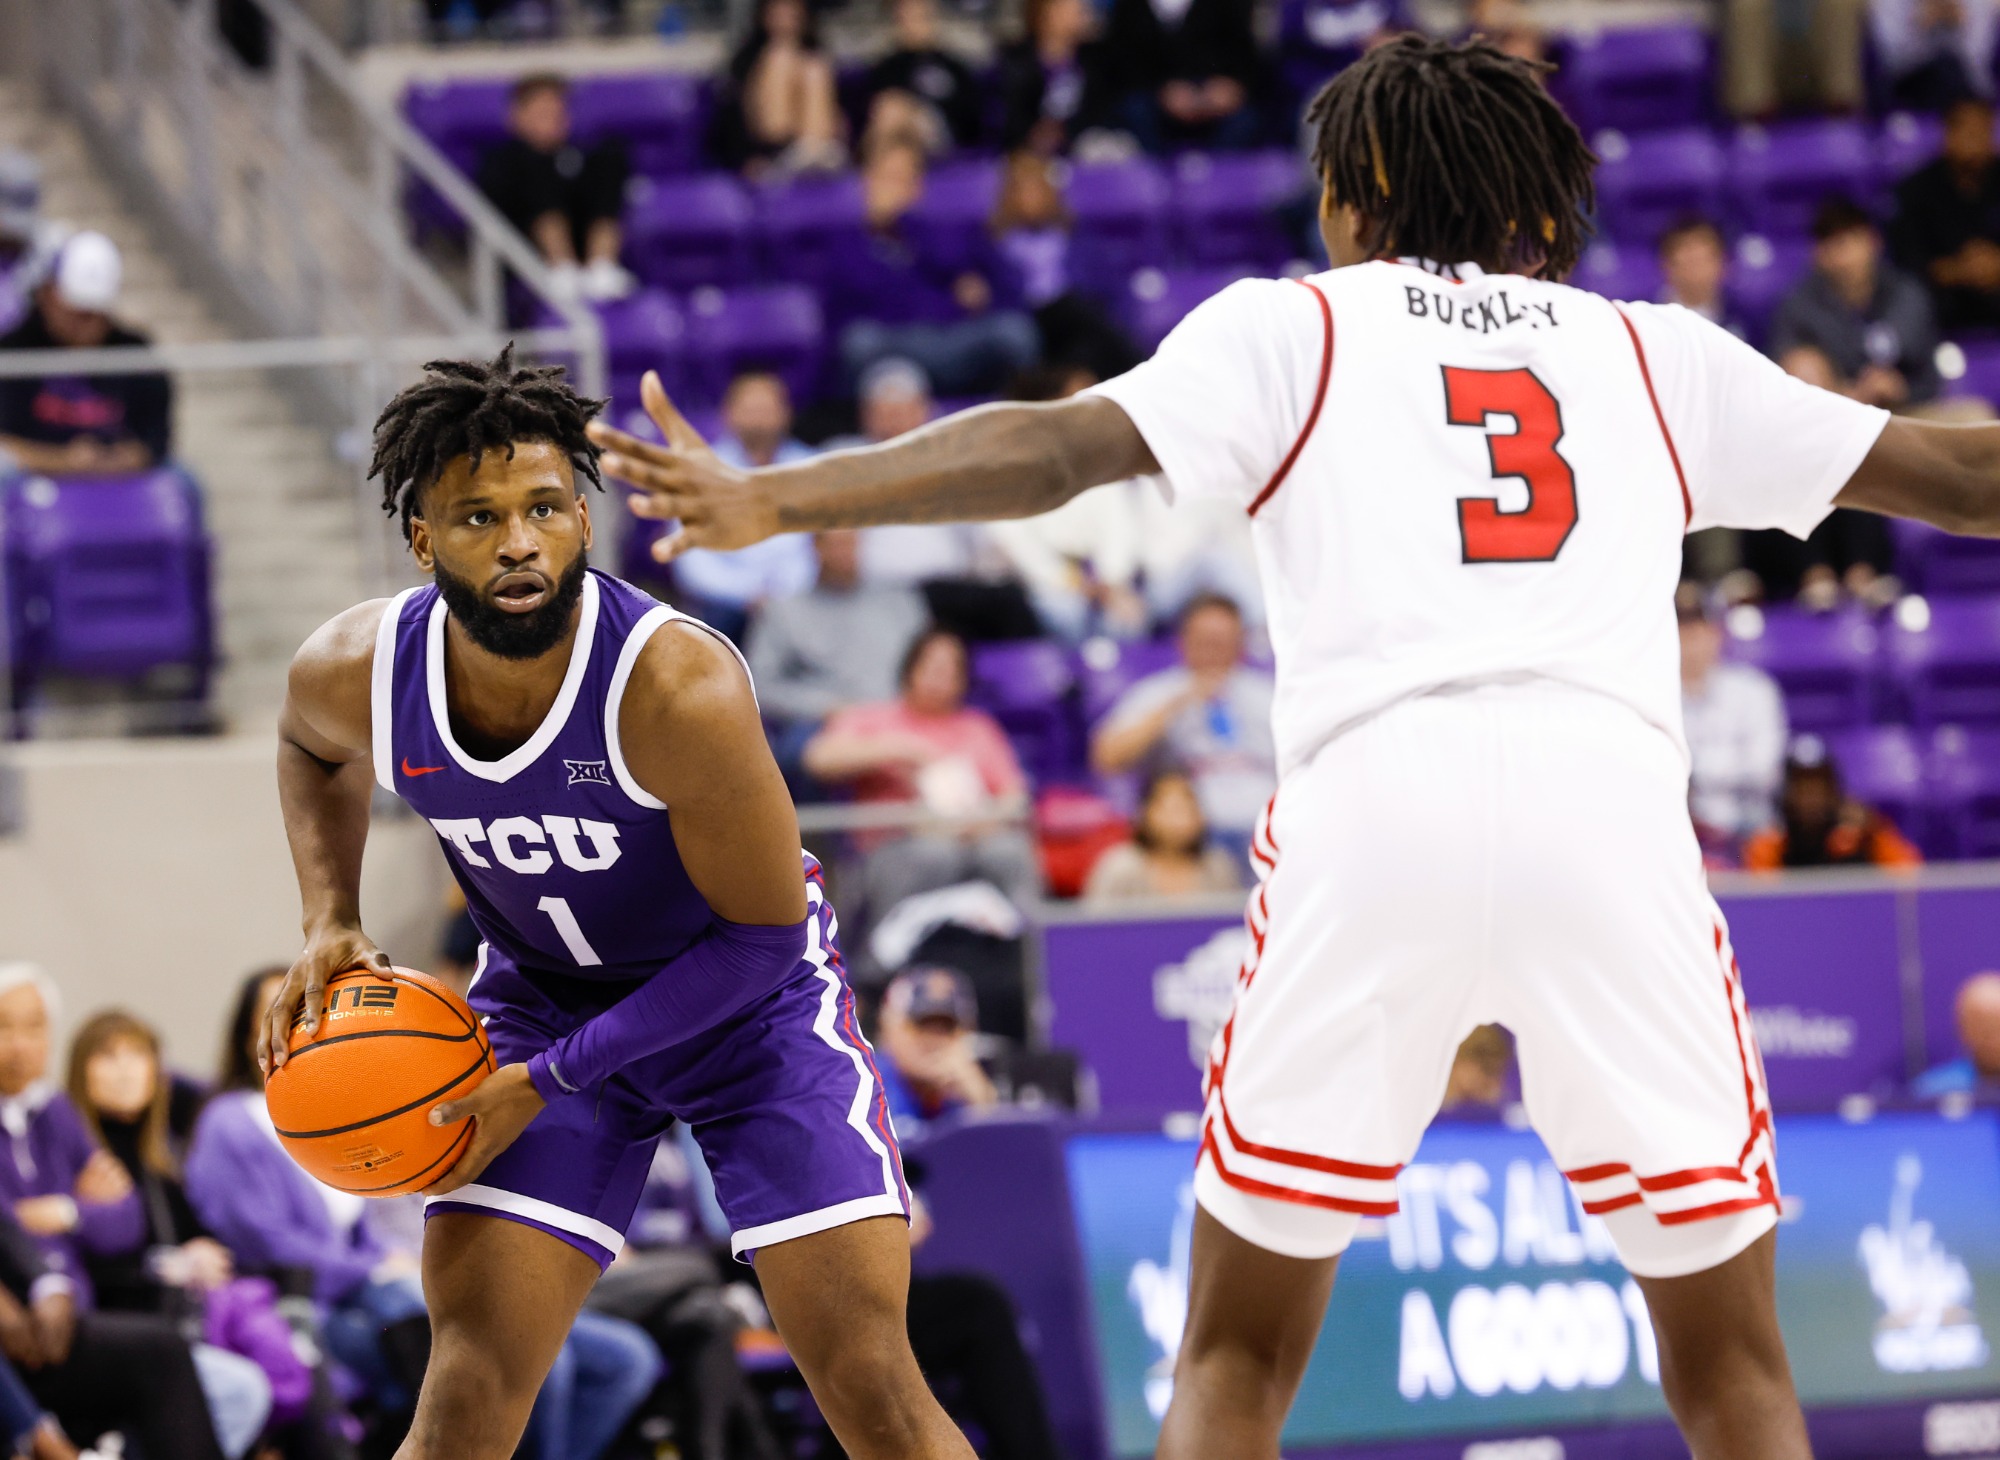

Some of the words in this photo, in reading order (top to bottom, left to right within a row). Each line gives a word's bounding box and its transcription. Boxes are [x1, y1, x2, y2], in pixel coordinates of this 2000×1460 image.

[1404, 285, 1559, 334] BUCKLY
[1440, 363, 1579, 564] 3
[428, 814, 623, 875] TCU
[537, 896, 603, 967] 1
[1398, 1286, 1456, 1402] A
